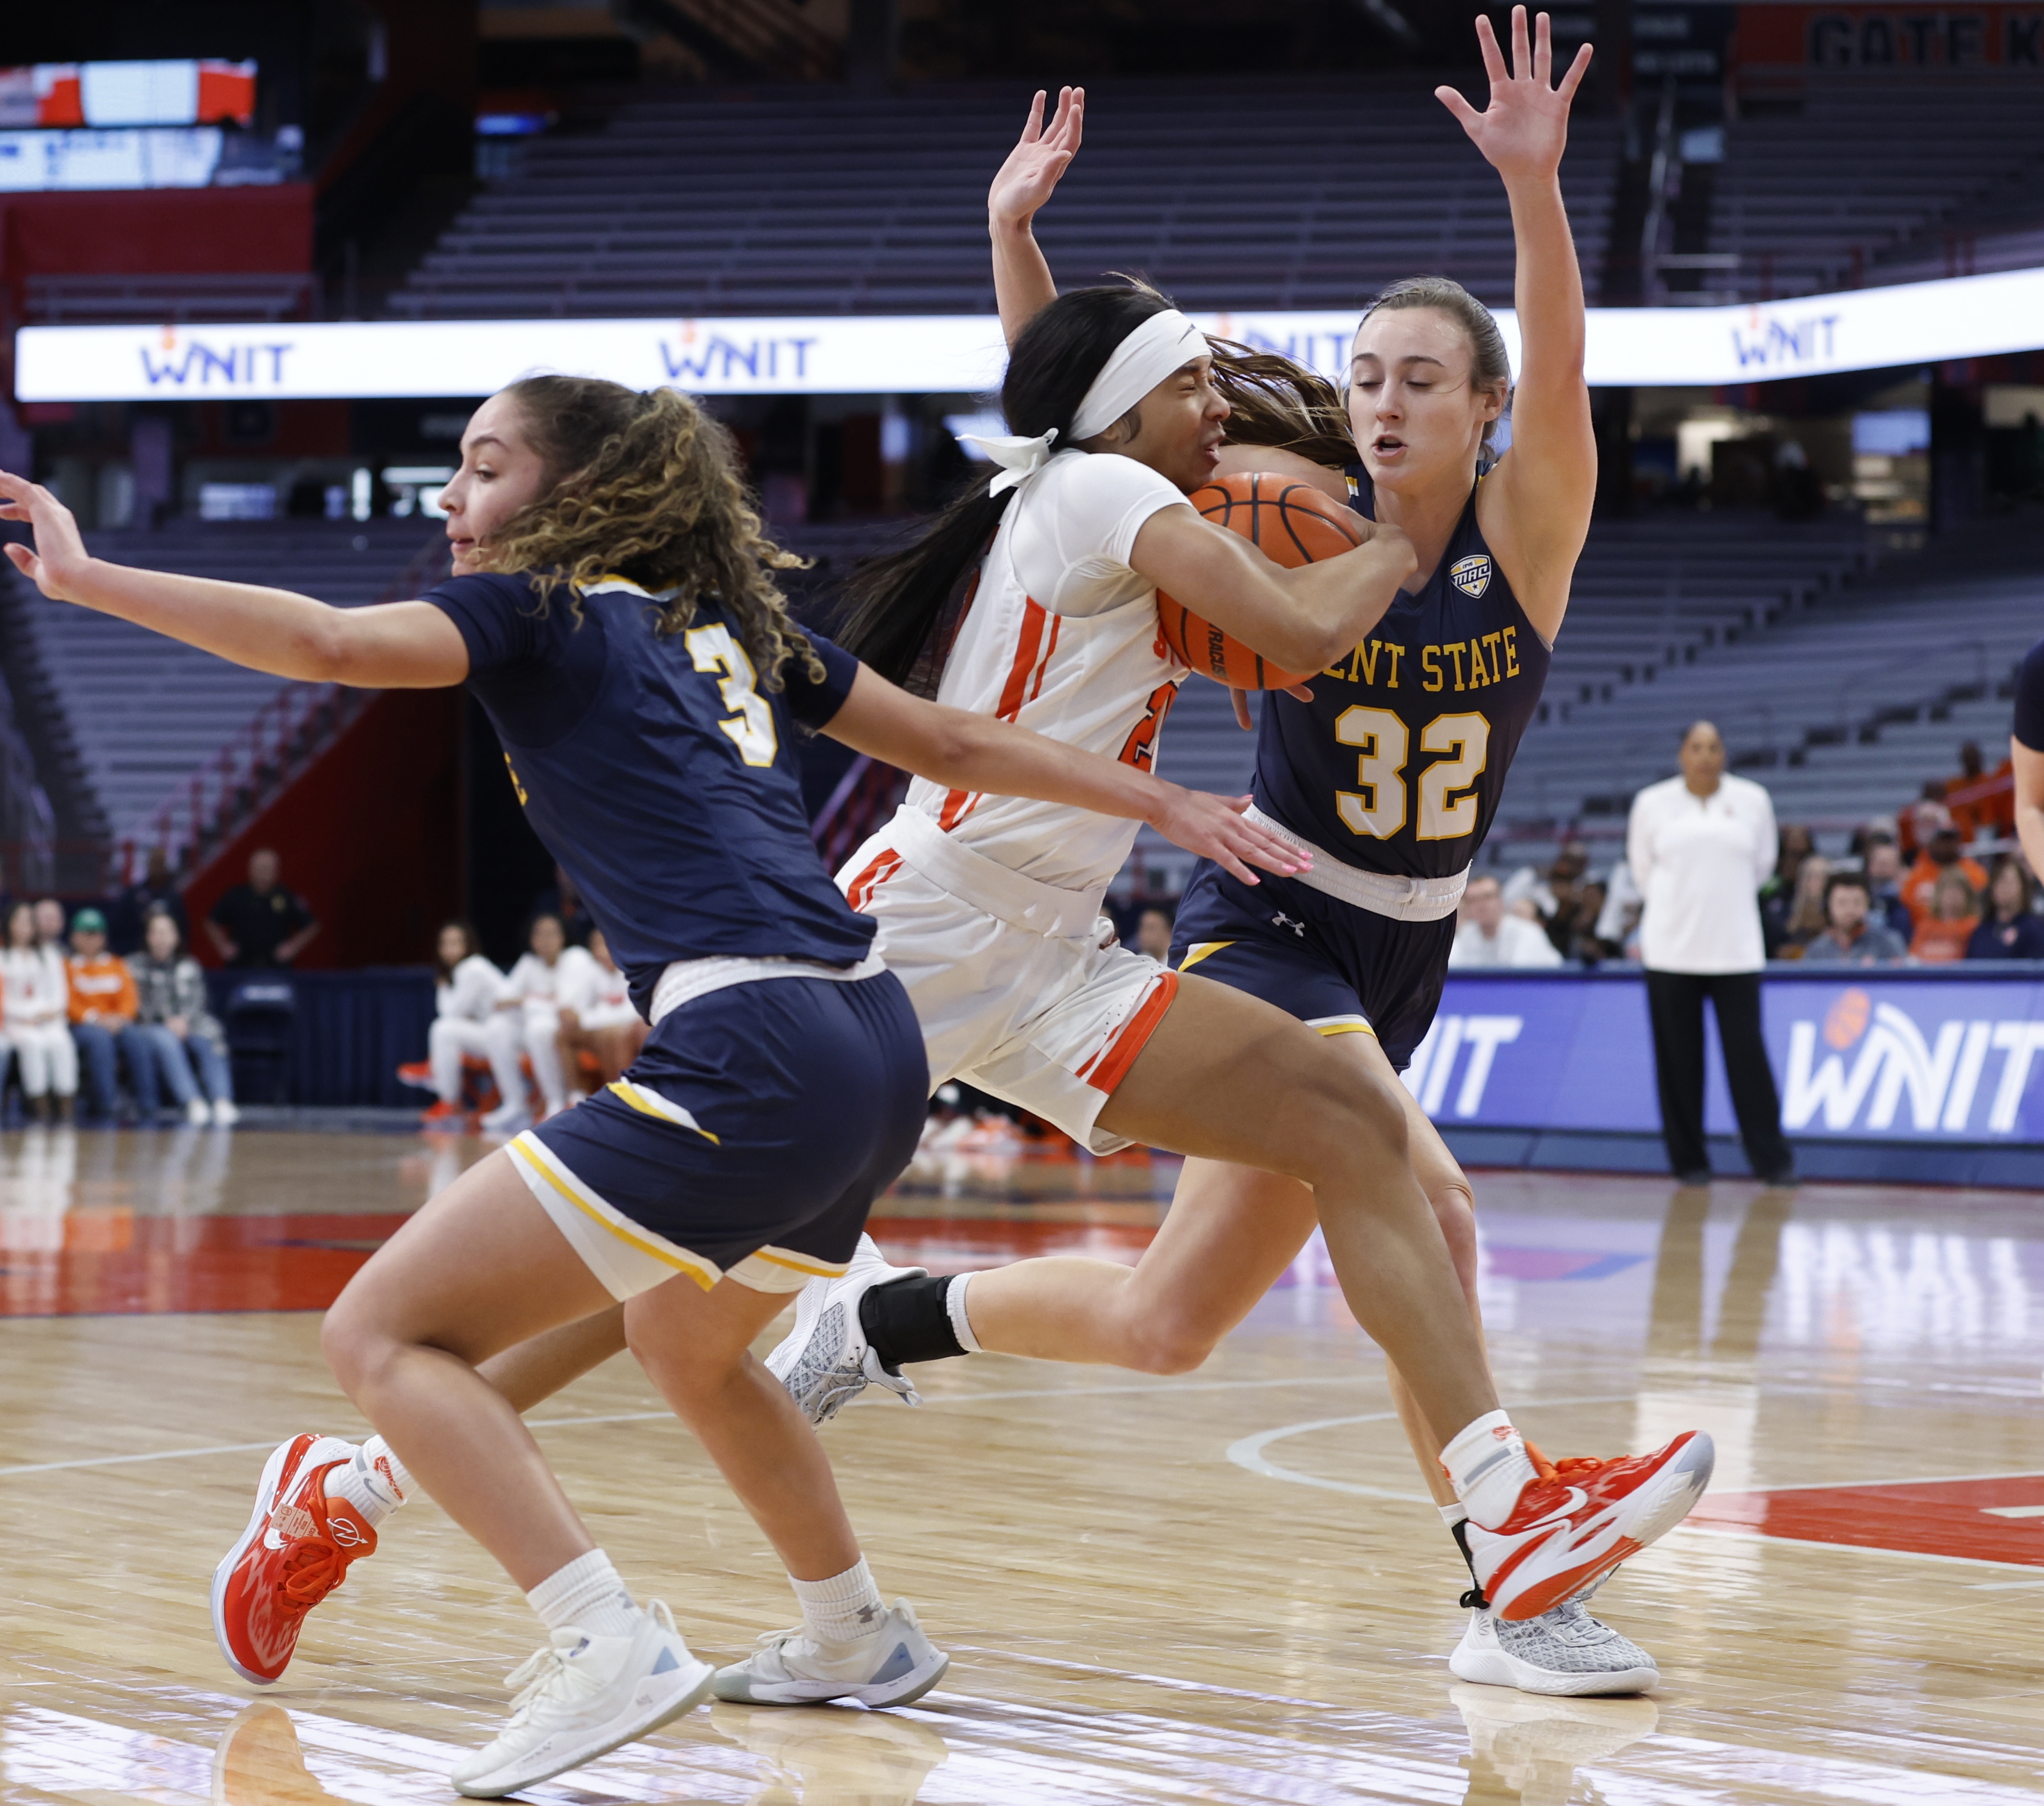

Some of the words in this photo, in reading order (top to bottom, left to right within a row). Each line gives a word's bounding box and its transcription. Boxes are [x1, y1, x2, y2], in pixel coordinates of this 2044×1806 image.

[139, 341, 295, 384] WNIT
[659, 335, 818, 378] WNIT
[1454, 565, 1488, 585] MAC
[1323, 639, 1405, 688] NT
[1422, 625, 1520, 692] STATE
[684, 622, 779, 768] 3
[1335, 704, 1491, 842] 32
[1781, 1001, 2044, 1132] WNIT
